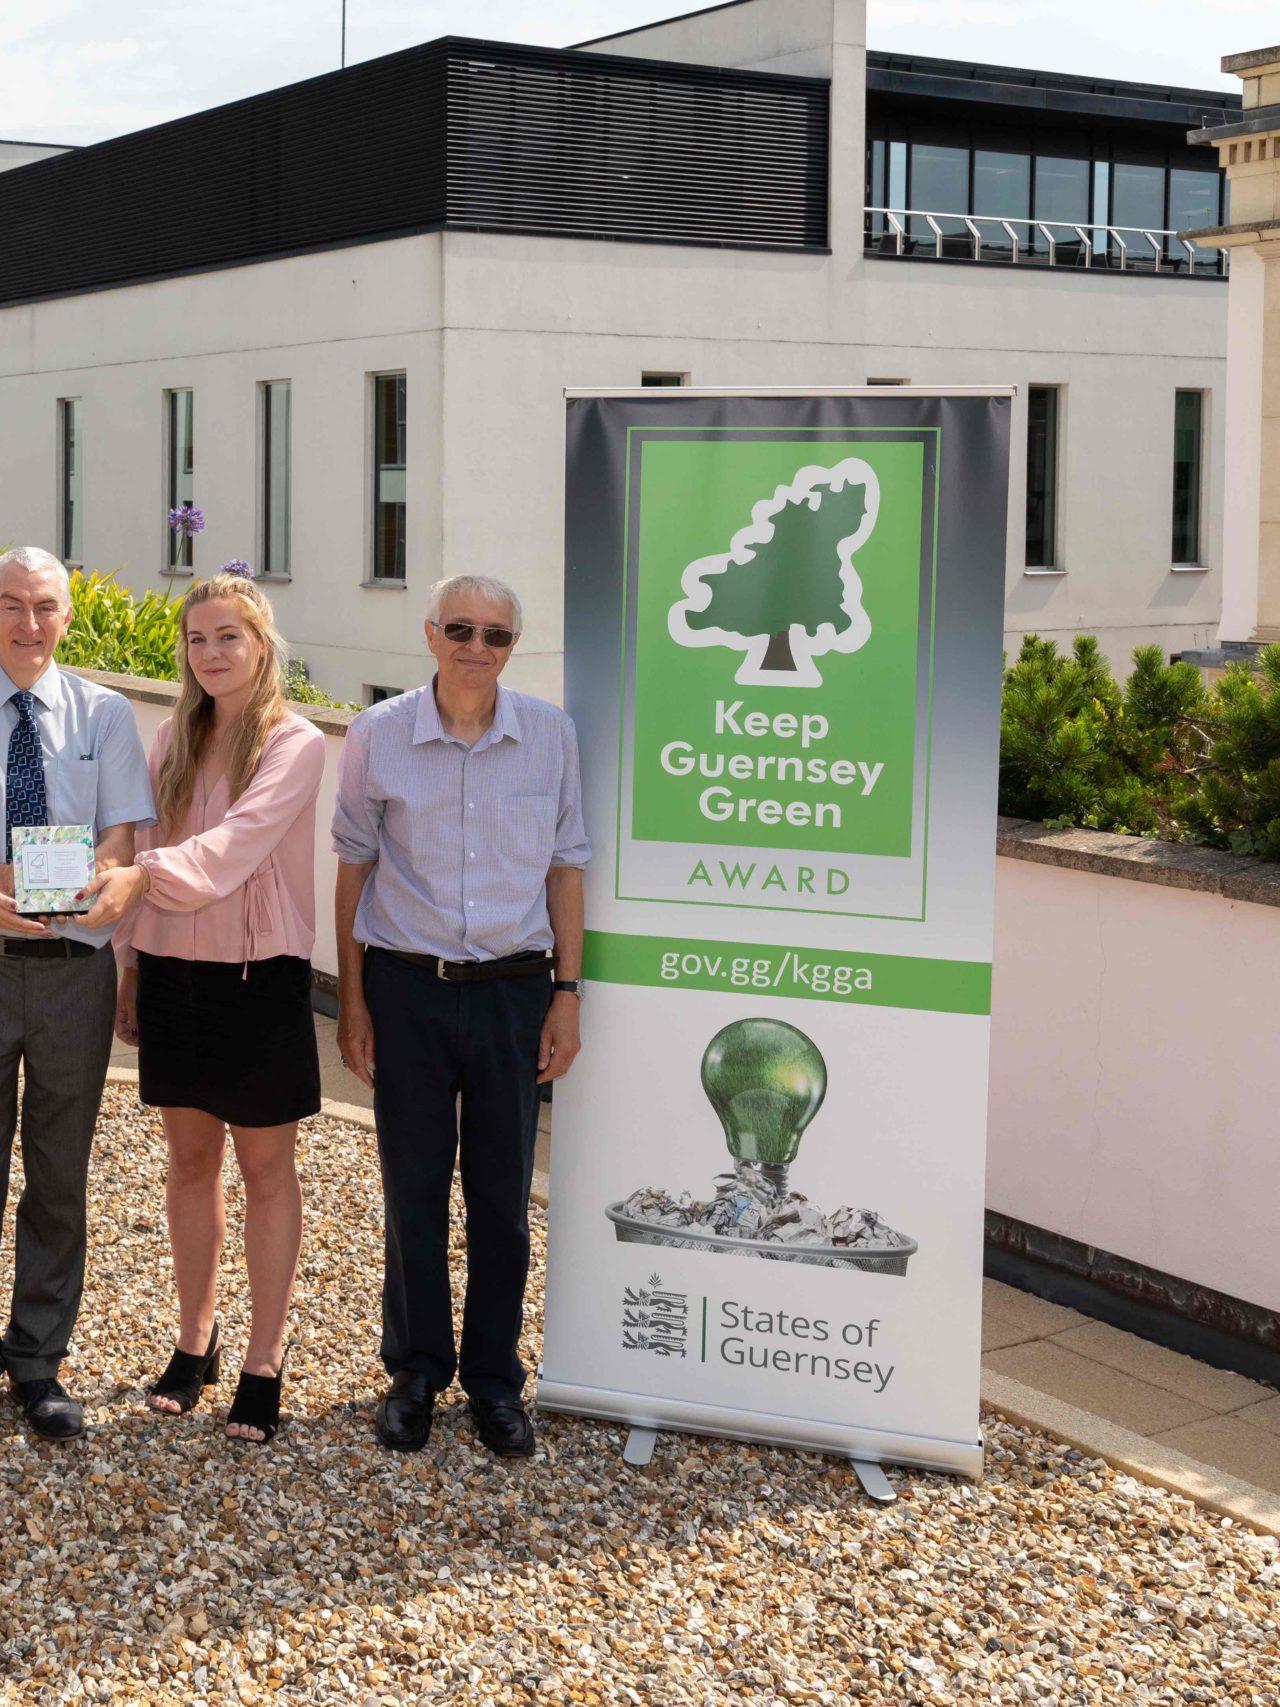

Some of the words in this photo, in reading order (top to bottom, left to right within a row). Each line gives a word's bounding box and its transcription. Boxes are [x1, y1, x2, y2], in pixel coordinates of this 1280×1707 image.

[714, 700, 829, 747] Keep
[660, 741, 884, 795] Guernsey
[698, 786, 841, 828] Green
[687, 859, 850, 895] AWARD
[660, 951, 873, 994] gov.gg/kgga
[720, 1301, 829, 1341] States
[842, 1318, 880, 1347] of
[720, 1337, 895, 1393] Guernsey
